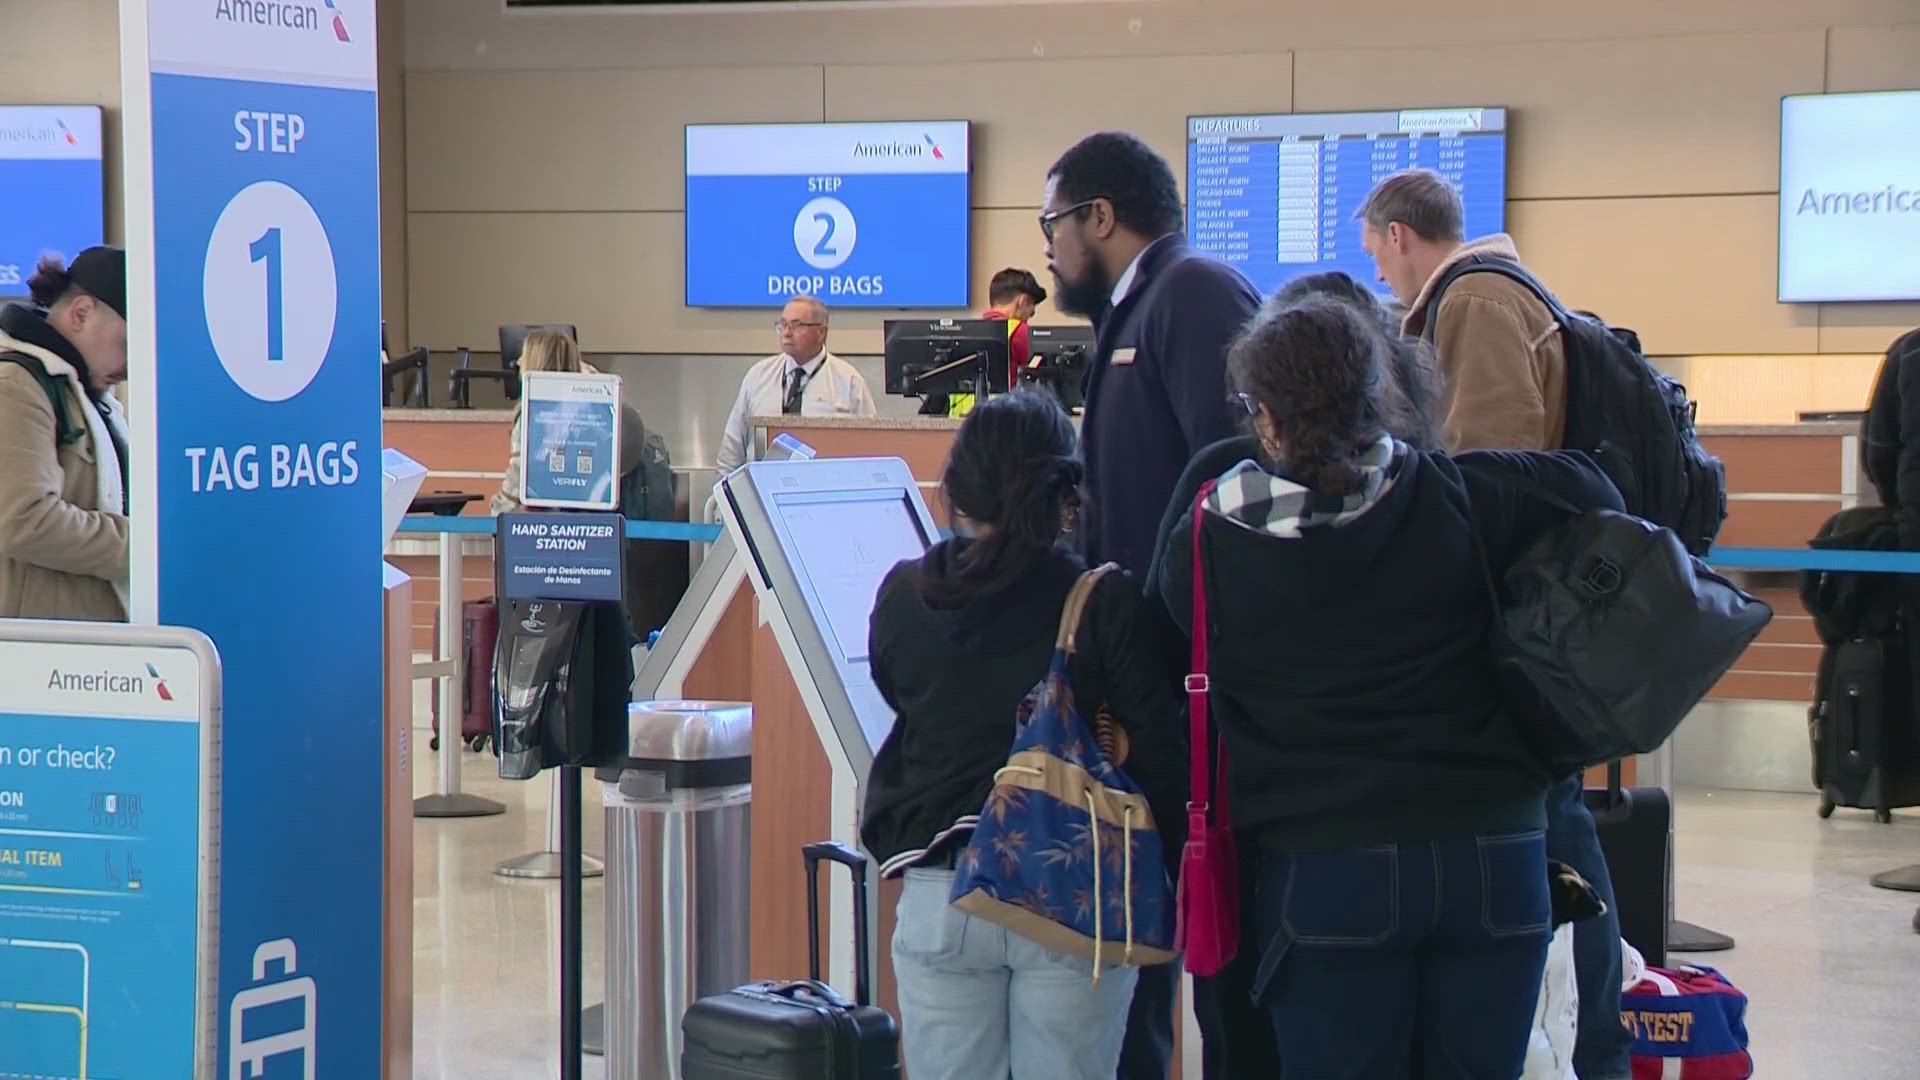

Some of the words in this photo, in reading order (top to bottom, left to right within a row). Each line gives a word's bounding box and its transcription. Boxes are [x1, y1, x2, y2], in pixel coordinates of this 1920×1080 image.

[216, 0, 318, 30] American
[234, 110, 305, 153] STEP
[1194, 119, 1261, 134] DEPARTURES
[1401, 118, 1437, 128] American
[853, 140, 922, 158] American
[808, 176, 842, 193] STEP
[813, 212, 837, 256] 2
[767, 275, 824, 295] DROP
[829, 275, 883, 295] BAGS
[249, 227, 284, 361] 1
[571, 386, 603, 394] American
[185, 445, 260, 492] TAG
[270, 441, 359, 489] BAGS
[552, 477, 588, 487] VERIFLY
[512, 524, 548, 536] HAND
[550, 525, 614, 537] SANITIZER
[536, 538, 587, 551] STATION
[514, 565, 546, 575] Estación
[547, 566, 557, 575] de
[558, 566, 612, 577] Desinfectante
[544, 576, 555, 584] de
[555, 576, 581, 585] Manos
[48, 669, 144, 694] American
[18, 747, 42, 766] or
[47, 743, 116, 770] check?
[25, 850, 62, 867] ITEM
[1640, 1011, 1694, 1042] TEST
